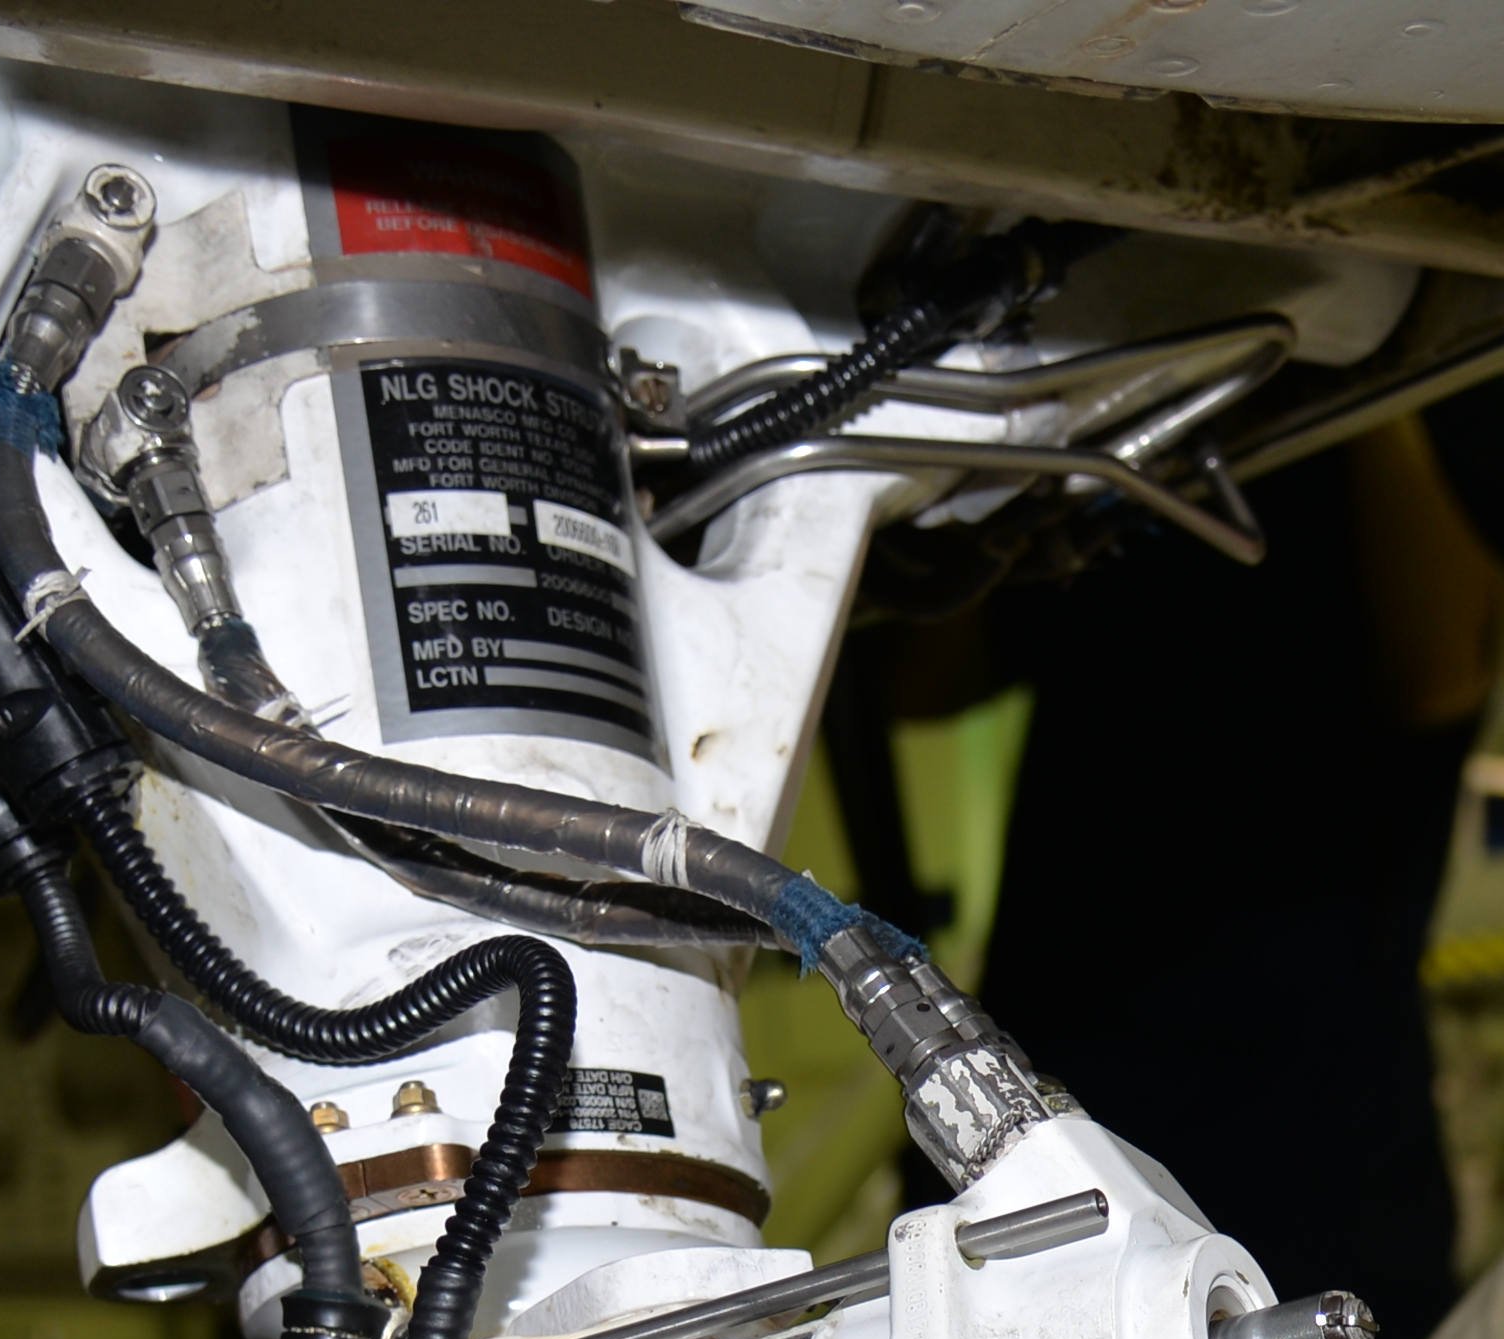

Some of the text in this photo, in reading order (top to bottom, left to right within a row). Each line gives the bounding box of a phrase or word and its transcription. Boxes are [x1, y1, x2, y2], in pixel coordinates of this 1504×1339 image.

[375, 215, 459, 233] BEFORE
[380, 373, 438, 401] NLG
[448, 374, 539, 409] SHOCK
[433, 405, 517, 425] MENASCO
[409, 422, 455, 437] FORT
[463, 423, 521, 442] WORTH
[526, 428, 570, 453] TEXAS
[424, 439, 474, 455] CODE
[479, 441, 525, 460] IDENT
[393, 459, 432, 474] MFD
[437, 459, 473, 473] FOR
[479, 459, 551, 483] GENERAL
[429, 473, 475, 489] FORT
[480, 474, 541, 496] WORTH
[413, 502, 439, 525] 261
[400, 534, 527, 556] SERIAL NO.
[408, 600, 516, 623] SPEC NO.
[548, 607, 612, 640] DESIGN
[413, 637, 503, 661] MFD BY
[416, 666, 478, 689] LCTN
[575, 1070, 608, 1083] DATE
[573, 1083, 606, 1095] DATE
[608, 1083, 635, 1096] MFR
